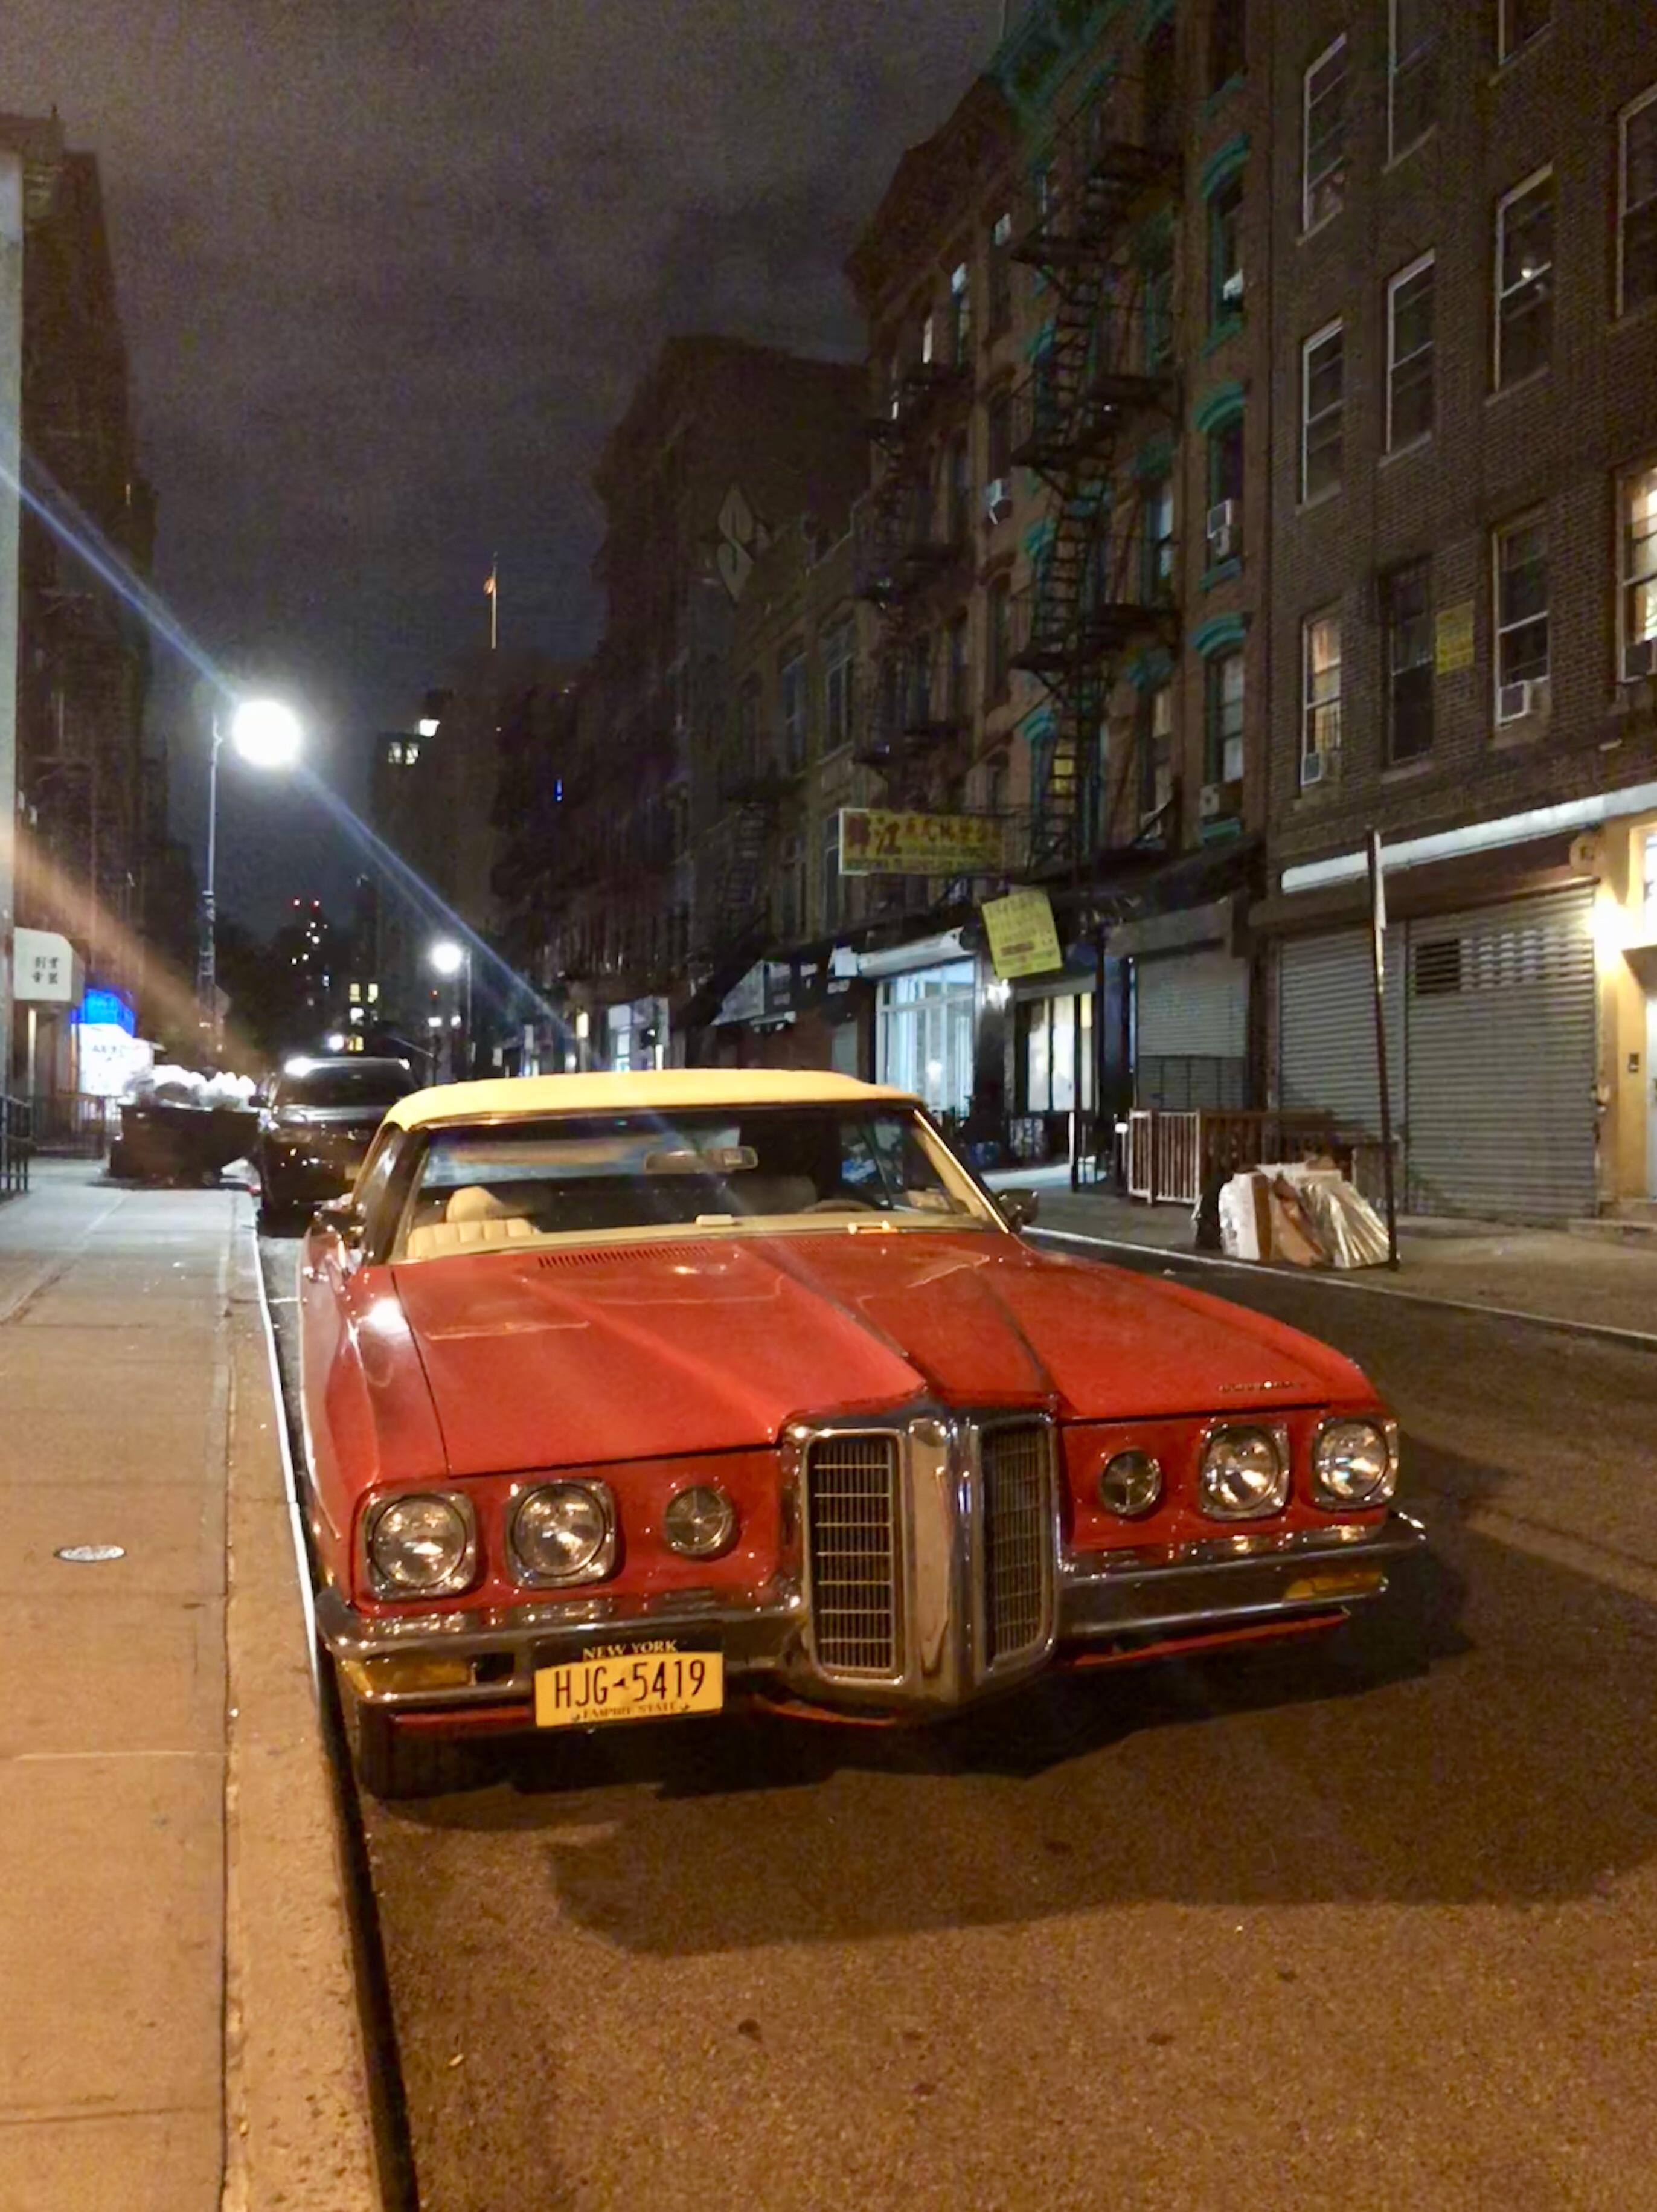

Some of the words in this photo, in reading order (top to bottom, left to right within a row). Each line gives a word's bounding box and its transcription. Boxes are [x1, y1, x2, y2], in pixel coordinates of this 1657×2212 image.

[583, 1644, 626, 1659] NEW
[632, 1640, 678, 1653] YORK
[554, 1666, 607, 1709] HJG
[633, 1659, 705, 1702] 5419
